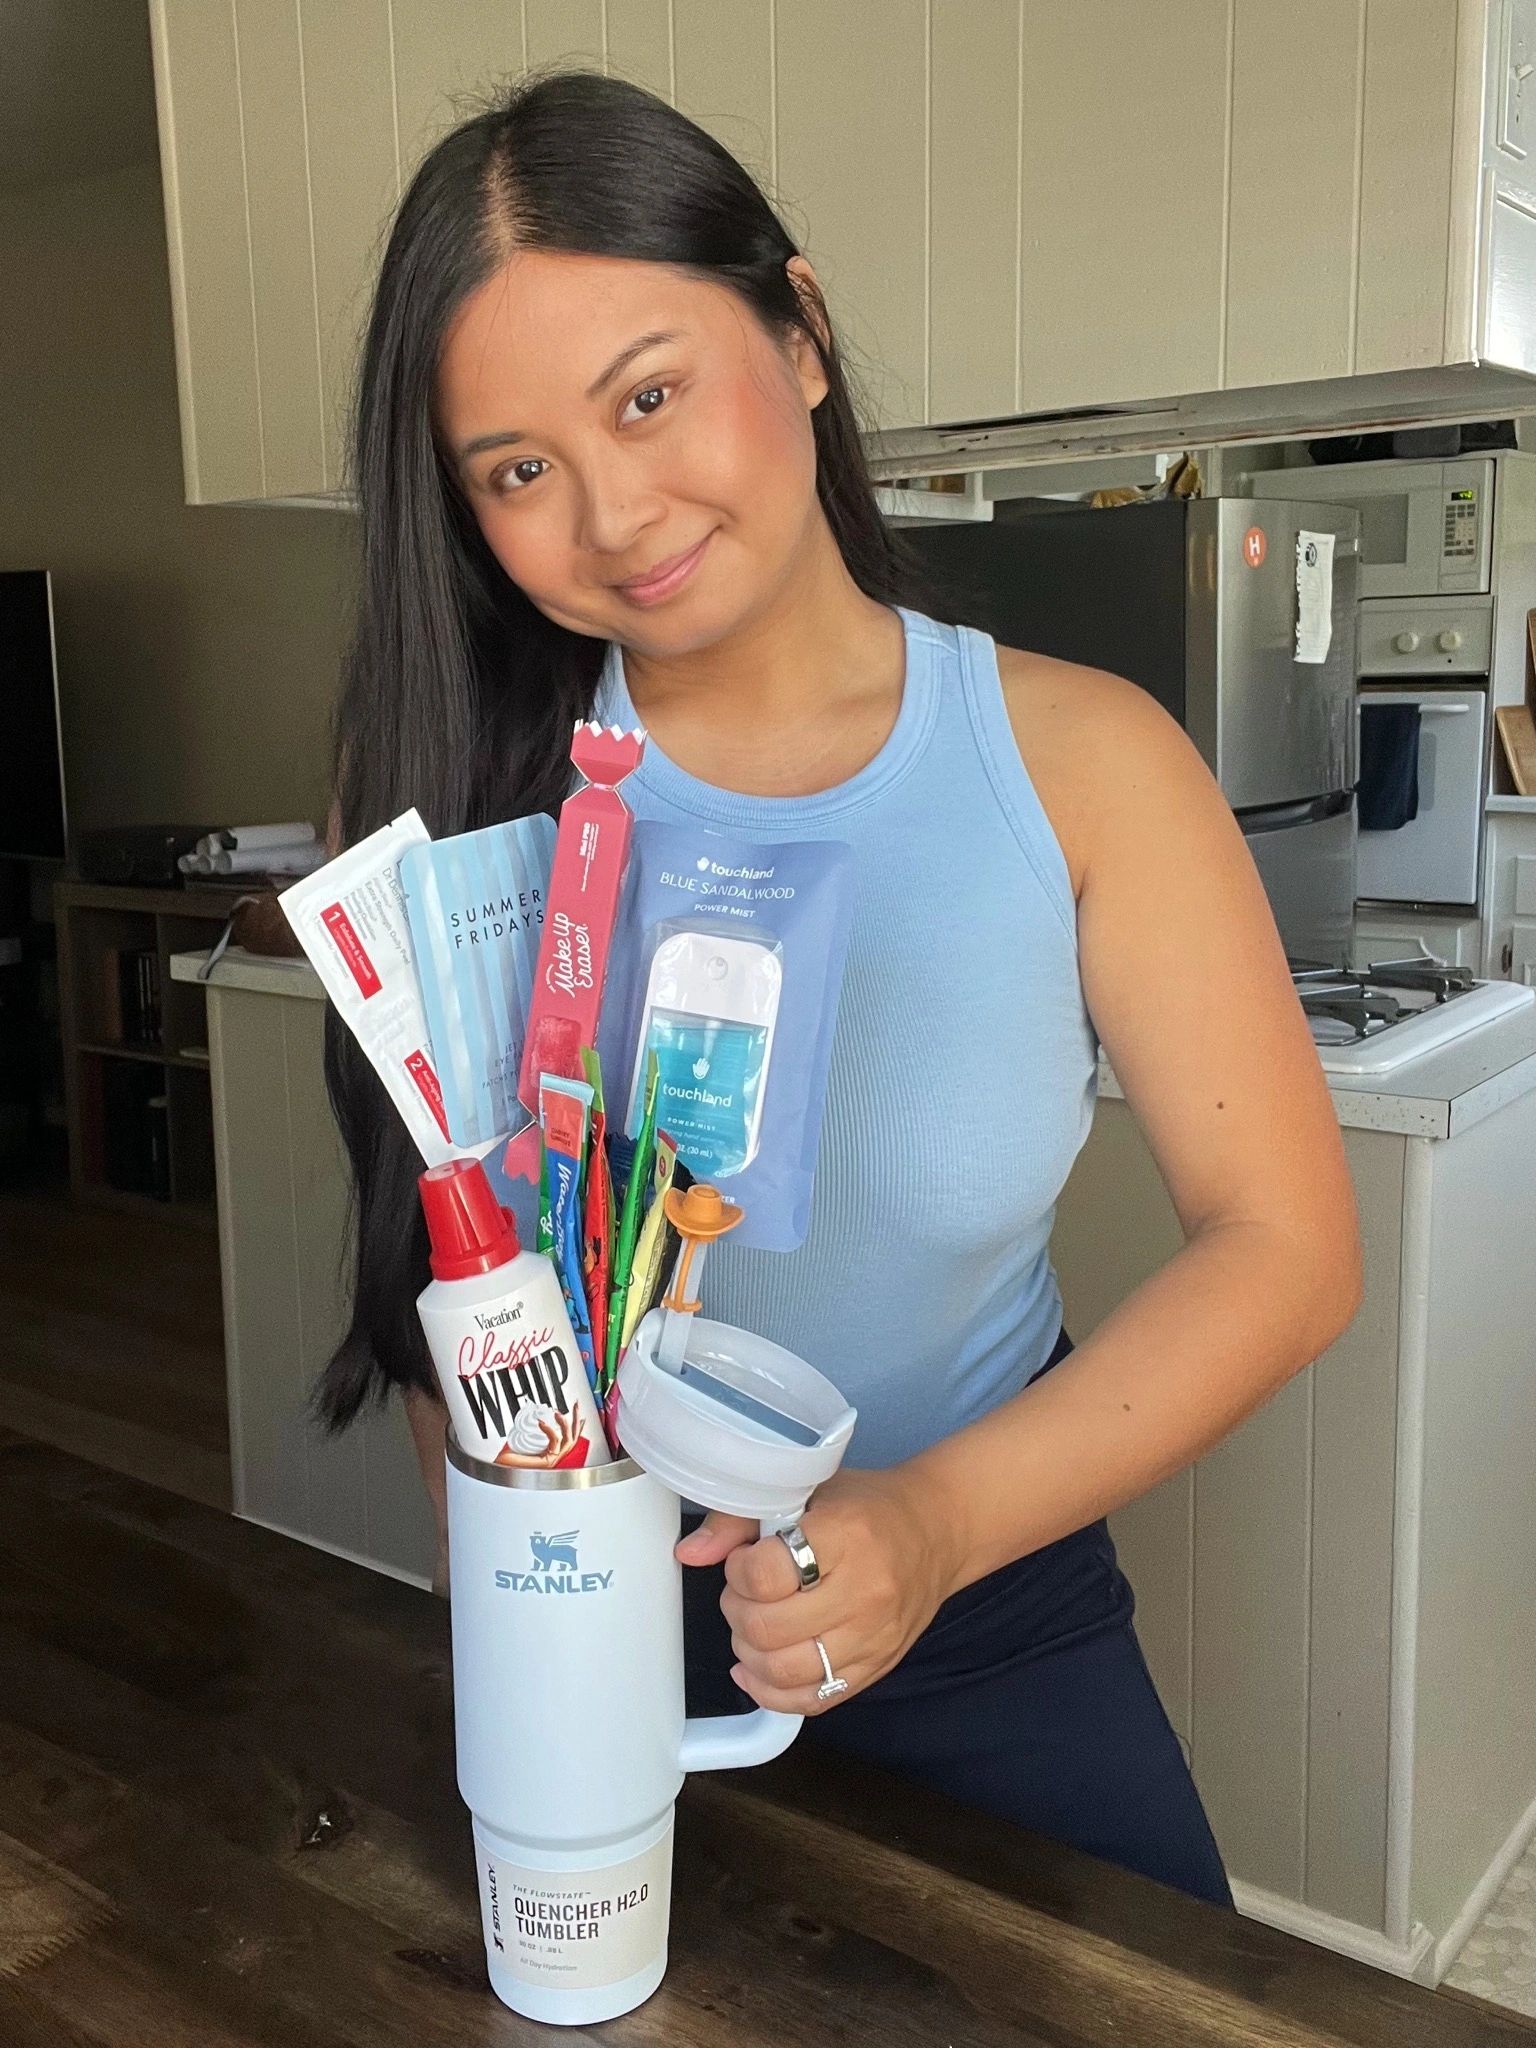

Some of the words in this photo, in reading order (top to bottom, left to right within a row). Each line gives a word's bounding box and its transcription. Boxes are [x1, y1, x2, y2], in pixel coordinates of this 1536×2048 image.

[711, 862, 775, 880] touchland
[660, 872, 698, 891] BLUE
[700, 882, 795, 900] SANDALWOOD
[325, 909, 342, 923] 1
[451, 889, 541, 927] SUMMER
[694, 904, 728, 914] POWER
[730, 907, 756, 918] MIST
[455, 909, 544, 949] FRIDAYS
[408, 1056, 425, 1072] 2
[662, 1083, 733, 1107] touchland
[667, 1117, 695, 1127] POWER
[697, 1122, 716, 1131] MIST
[459, 1326, 555, 1380] Classic
[458, 1345, 569, 1440] WHIP
[494, 1569, 614, 1594] STANLEY
[487, 1863, 501, 1932] STANLEY
[513, 1883, 528, 1895] THE
[514, 1897, 611, 1922] QUENCHER
[617, 1883, 649, 1913] H2.0
[515, 1915, 599, 1941] TUMBLER
